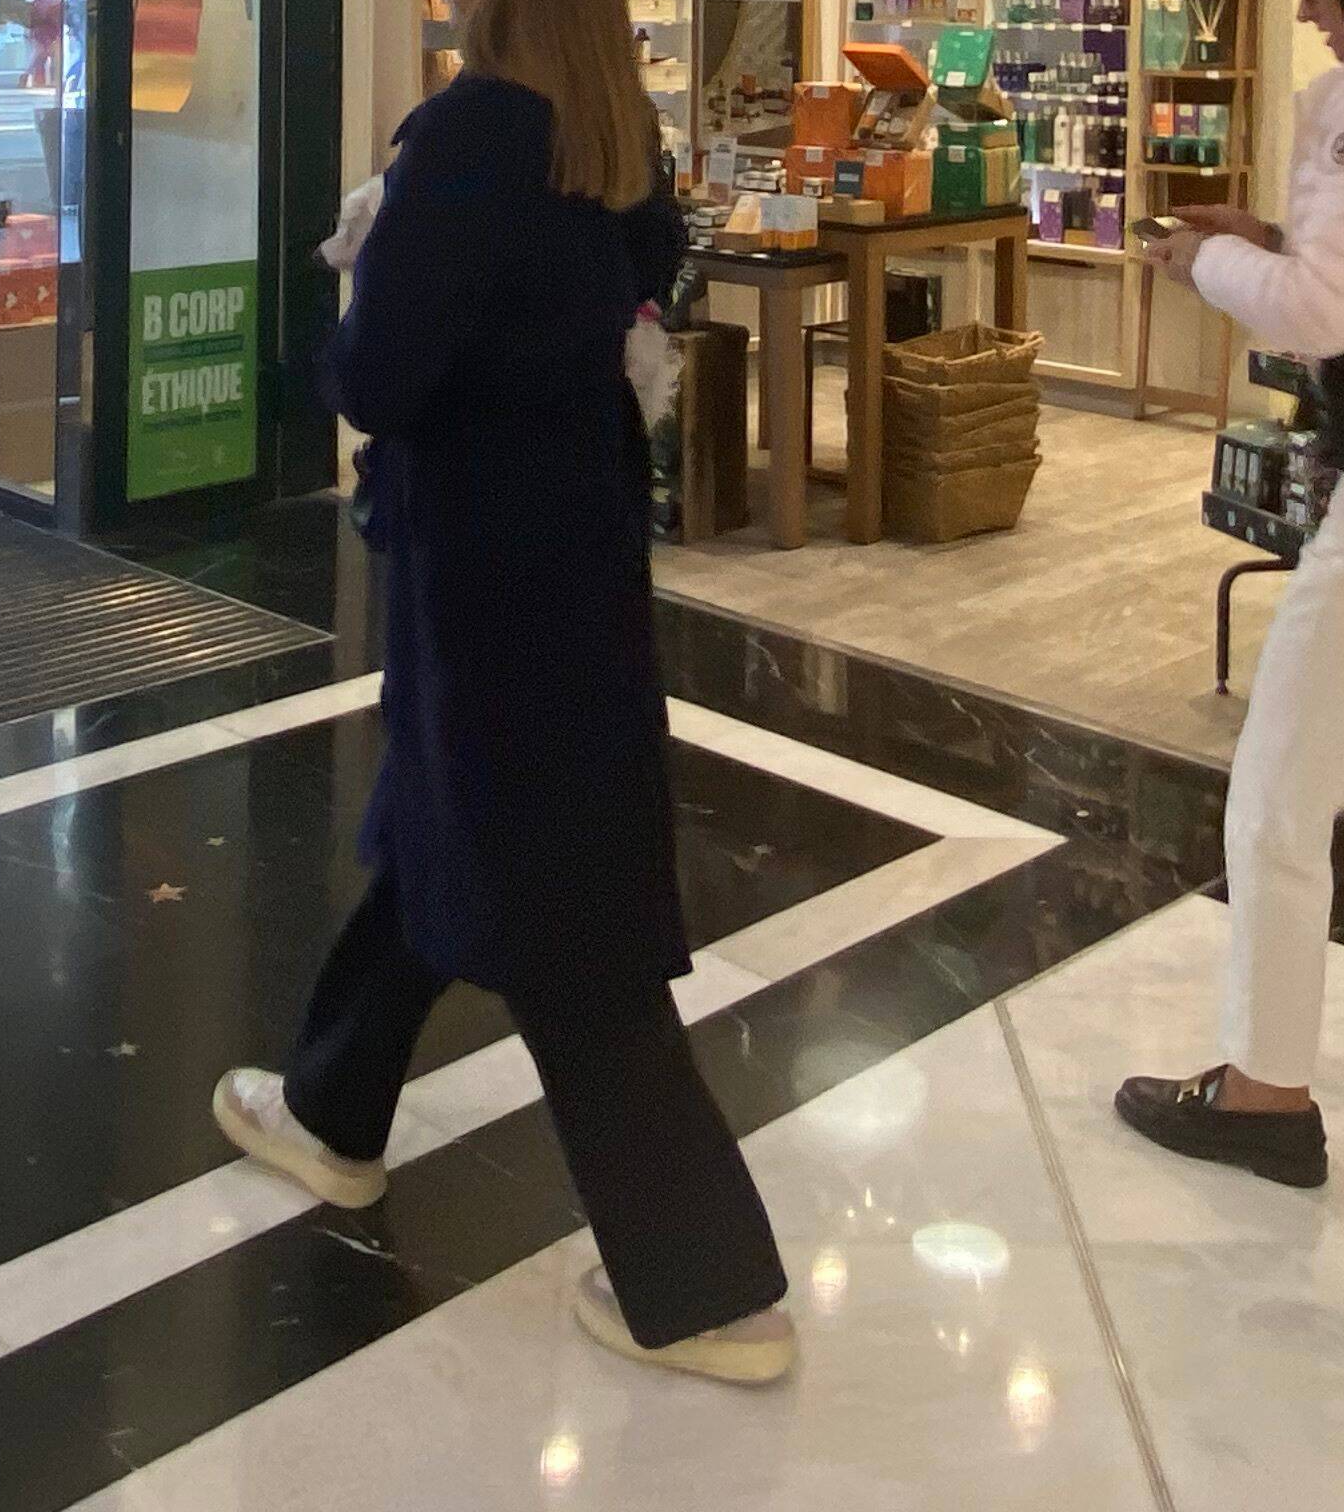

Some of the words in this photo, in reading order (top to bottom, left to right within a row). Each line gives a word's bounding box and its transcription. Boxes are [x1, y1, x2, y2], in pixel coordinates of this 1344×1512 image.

[142, 294, 163, 341] B
[169, 286, 244, 338] CORP
[141, 362, 244, 418] ÉTHIQUE
